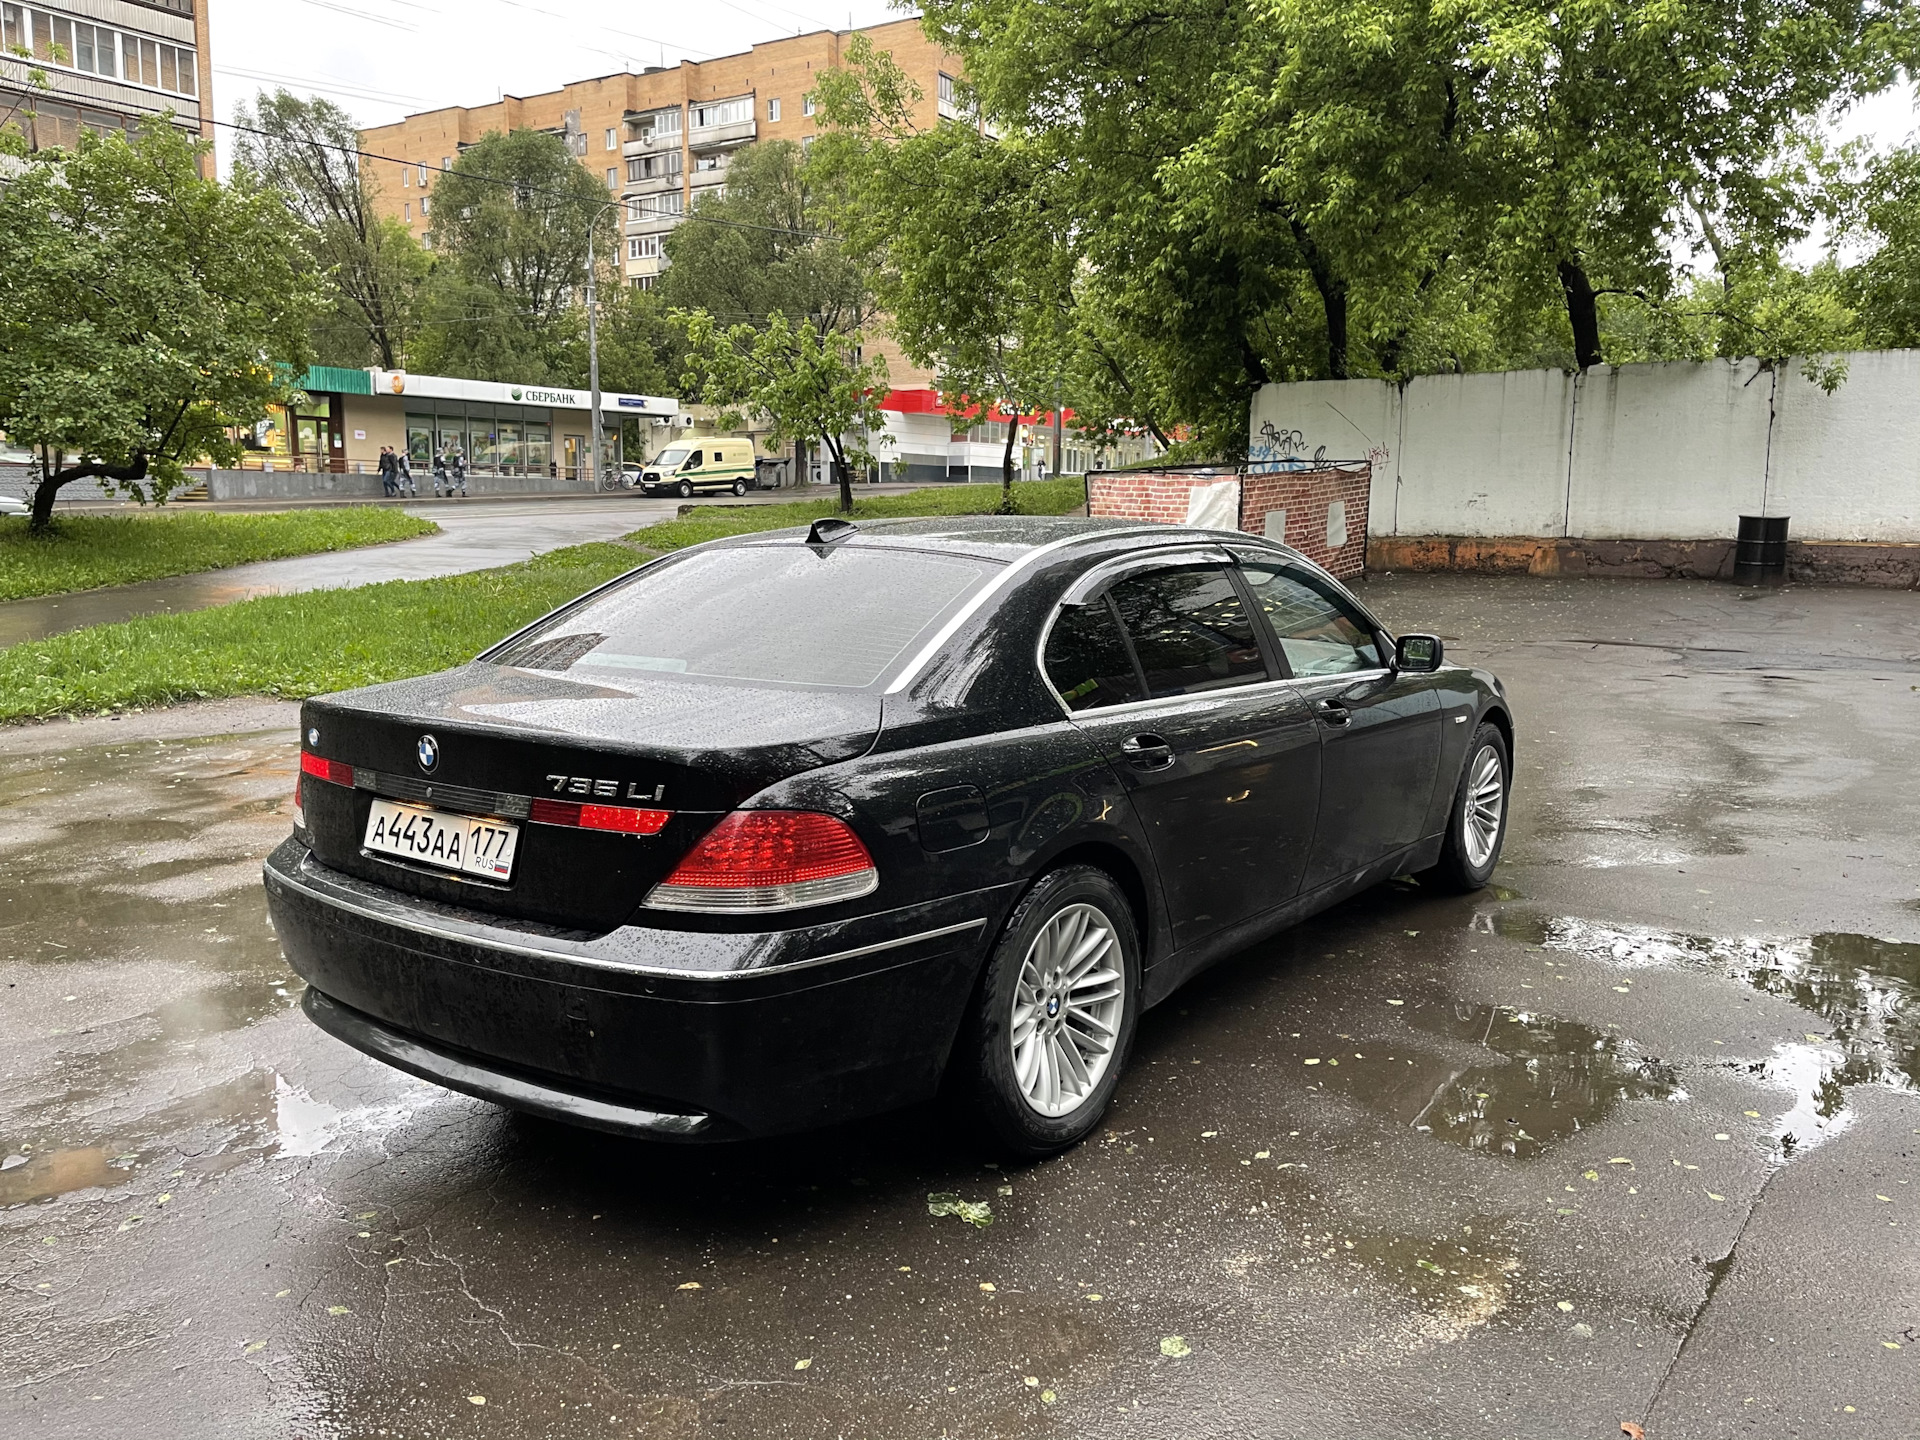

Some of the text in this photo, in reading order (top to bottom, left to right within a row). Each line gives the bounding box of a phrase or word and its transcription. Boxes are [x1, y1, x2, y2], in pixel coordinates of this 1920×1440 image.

[525, 390, 576, 405] СБЕРБАНК
[546, 775, 619, 797] 735
[471, 826, 509, 859] 177
[474, 856, 495, 870] RUS
